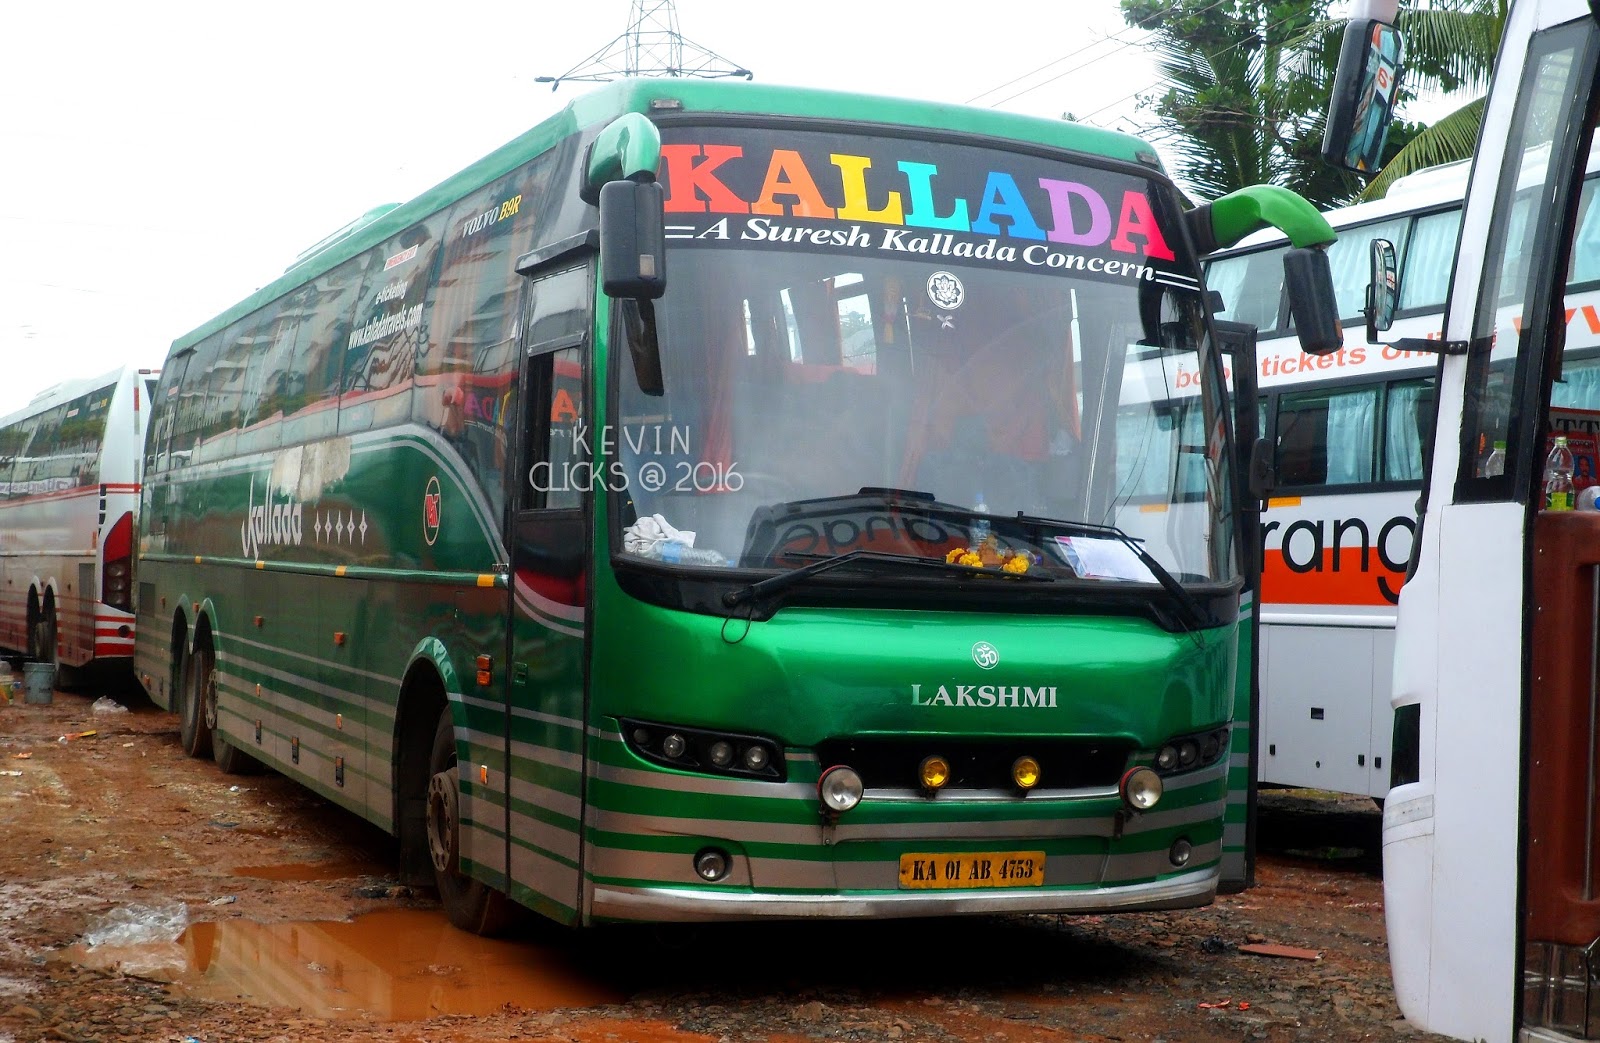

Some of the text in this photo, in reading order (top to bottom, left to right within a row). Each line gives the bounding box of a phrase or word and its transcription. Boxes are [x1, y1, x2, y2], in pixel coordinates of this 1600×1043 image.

[462, 194, 522, 239] VOLVO B9R
[660, 144, 1175, 261] KALLADA
[693, 217, 1157, 283] A Suresh Kallada Concern
[1260, 345, 1367, 377] tickets
[911, 684, 1058, 708] LAKSHMI
[912, 860, 937, 881] KA
[968, 860, 992, 880] AB
[998, 859, 1034, 880] 4753
